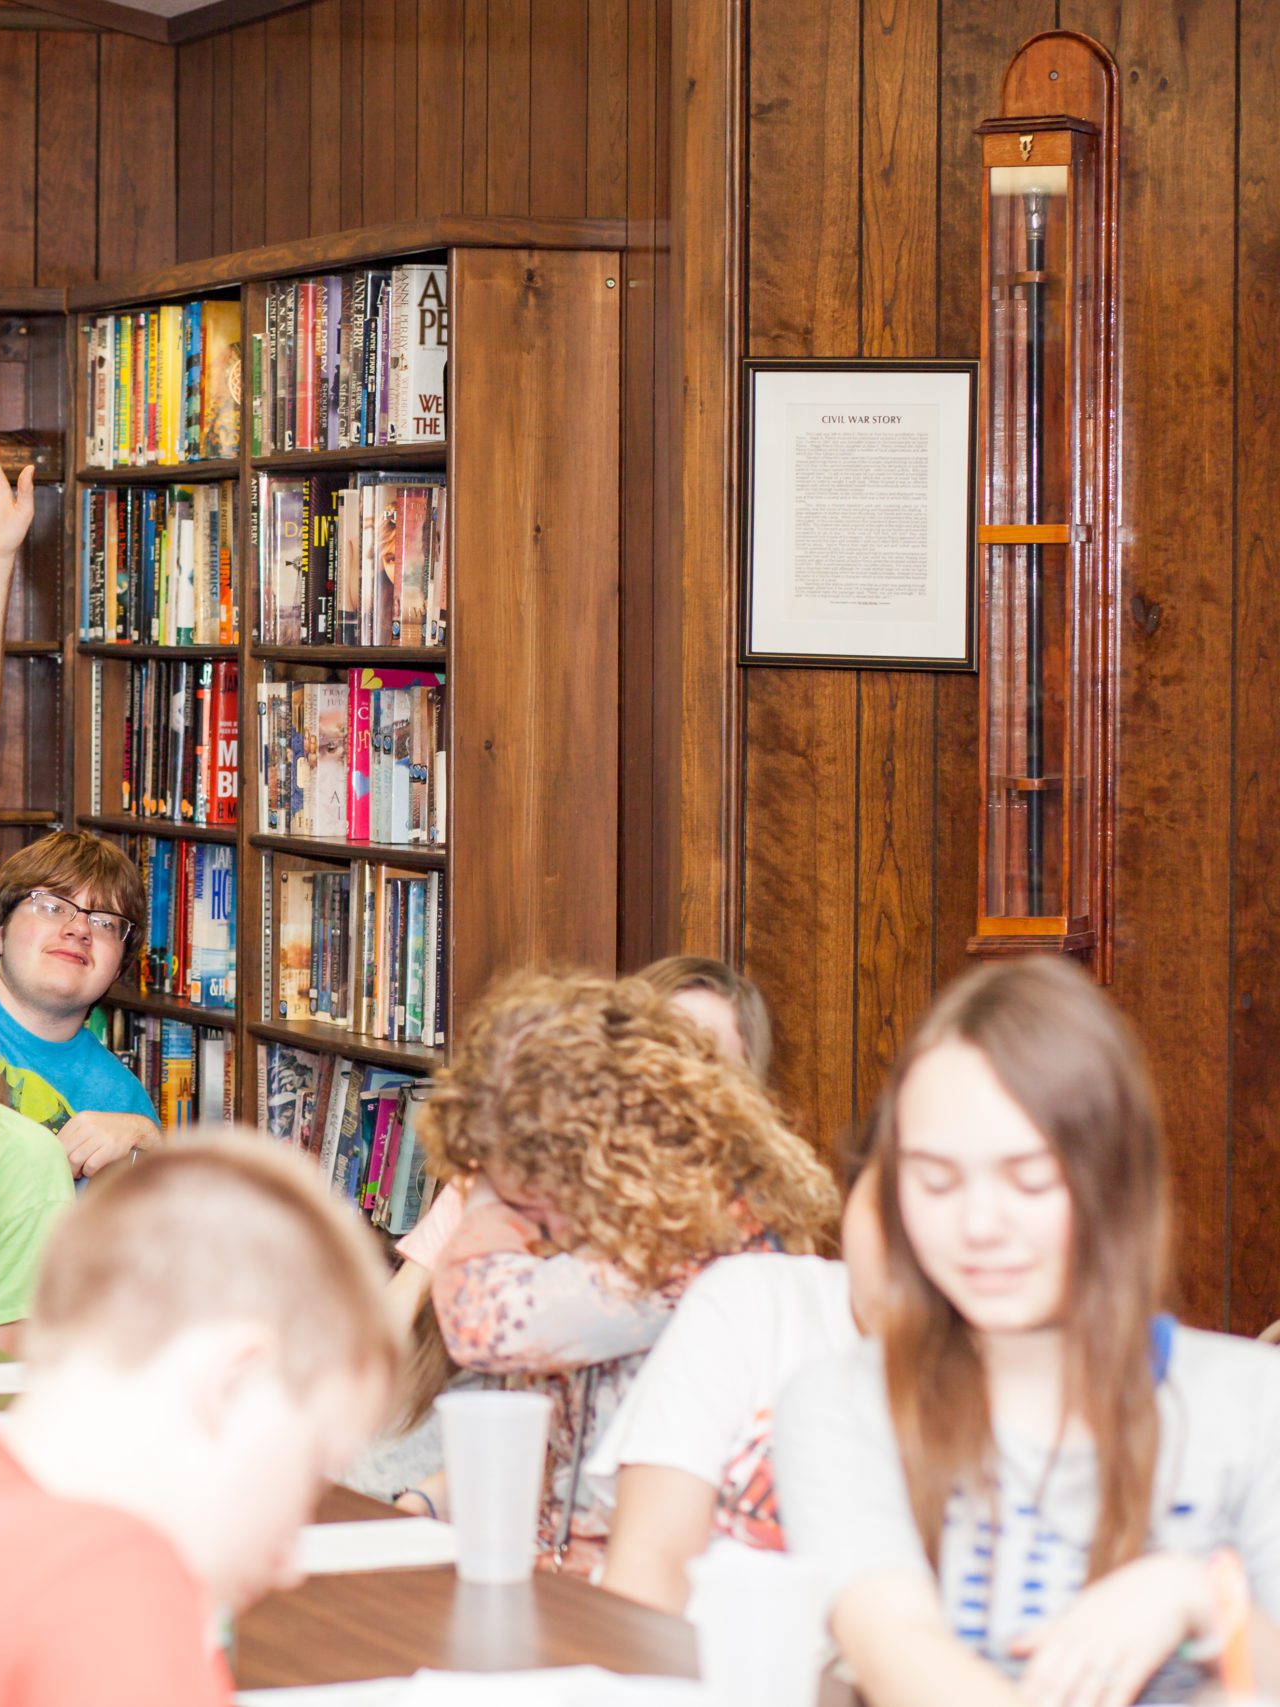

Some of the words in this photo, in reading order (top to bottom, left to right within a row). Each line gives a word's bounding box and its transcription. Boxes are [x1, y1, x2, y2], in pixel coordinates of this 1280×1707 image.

[353, 277, 366, 311] ANNE
[352, 313, 365, 351] PERRY
[412, 417, 442, 435] THE
[821, 415, 845, 425] CIVIL
[848, 415, 870, 425] WAR
[872, 415, 902, 425] STORY
[220, 548, 231, 588] BURN
[194, 847, 205, 900] HONEYMOON
[187, 882, 195, 945] PATTERSON
[223, 1088, 232, 1123] HOUSE
